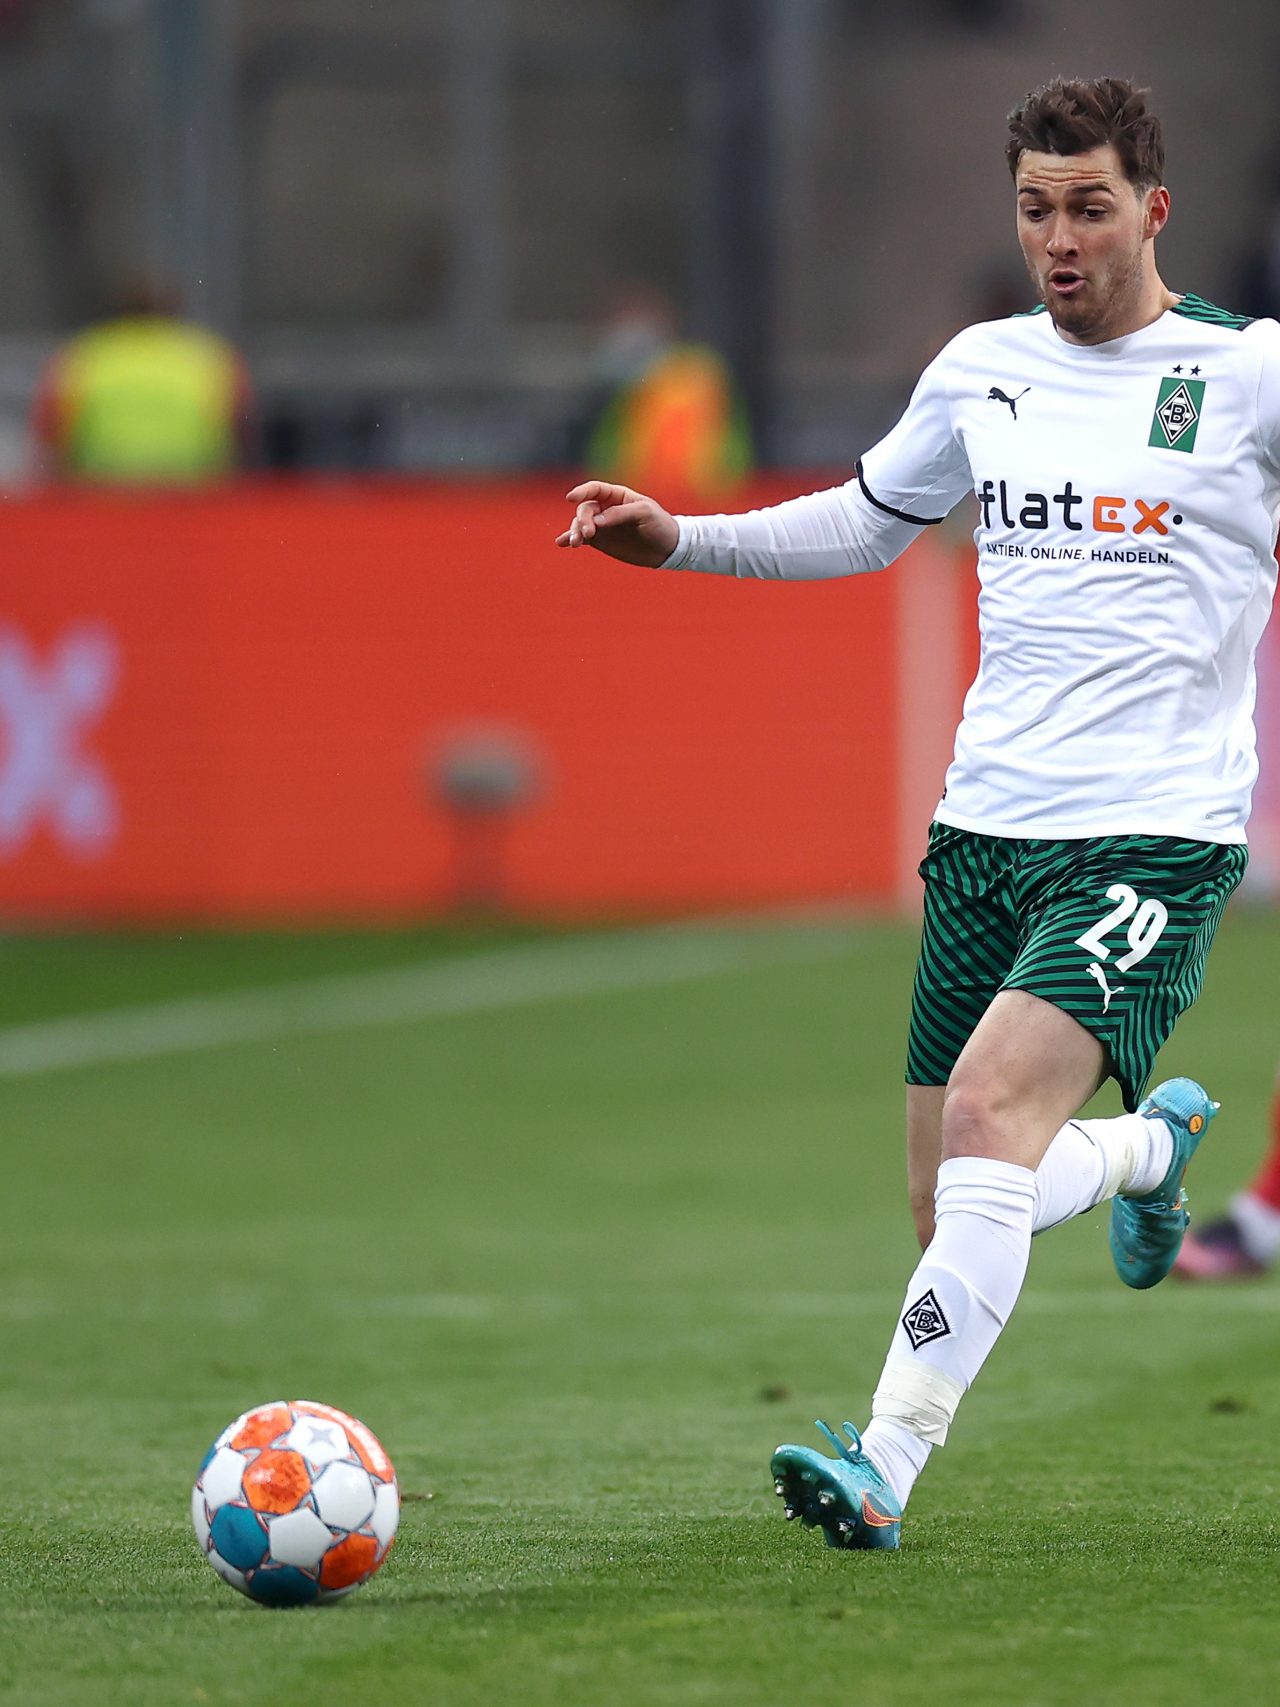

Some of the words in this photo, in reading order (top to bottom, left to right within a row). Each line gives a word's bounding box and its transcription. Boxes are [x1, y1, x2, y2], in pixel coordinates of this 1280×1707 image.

[1169, 403, 1187, 425] B
[986, 543, 1028, 558] AKTIEN.
[1030, 547, 1086, 561] ONLINE.
[1091, 550, 1175, 565] HANDELN.
[1074, 884, 1168, 973] 29
